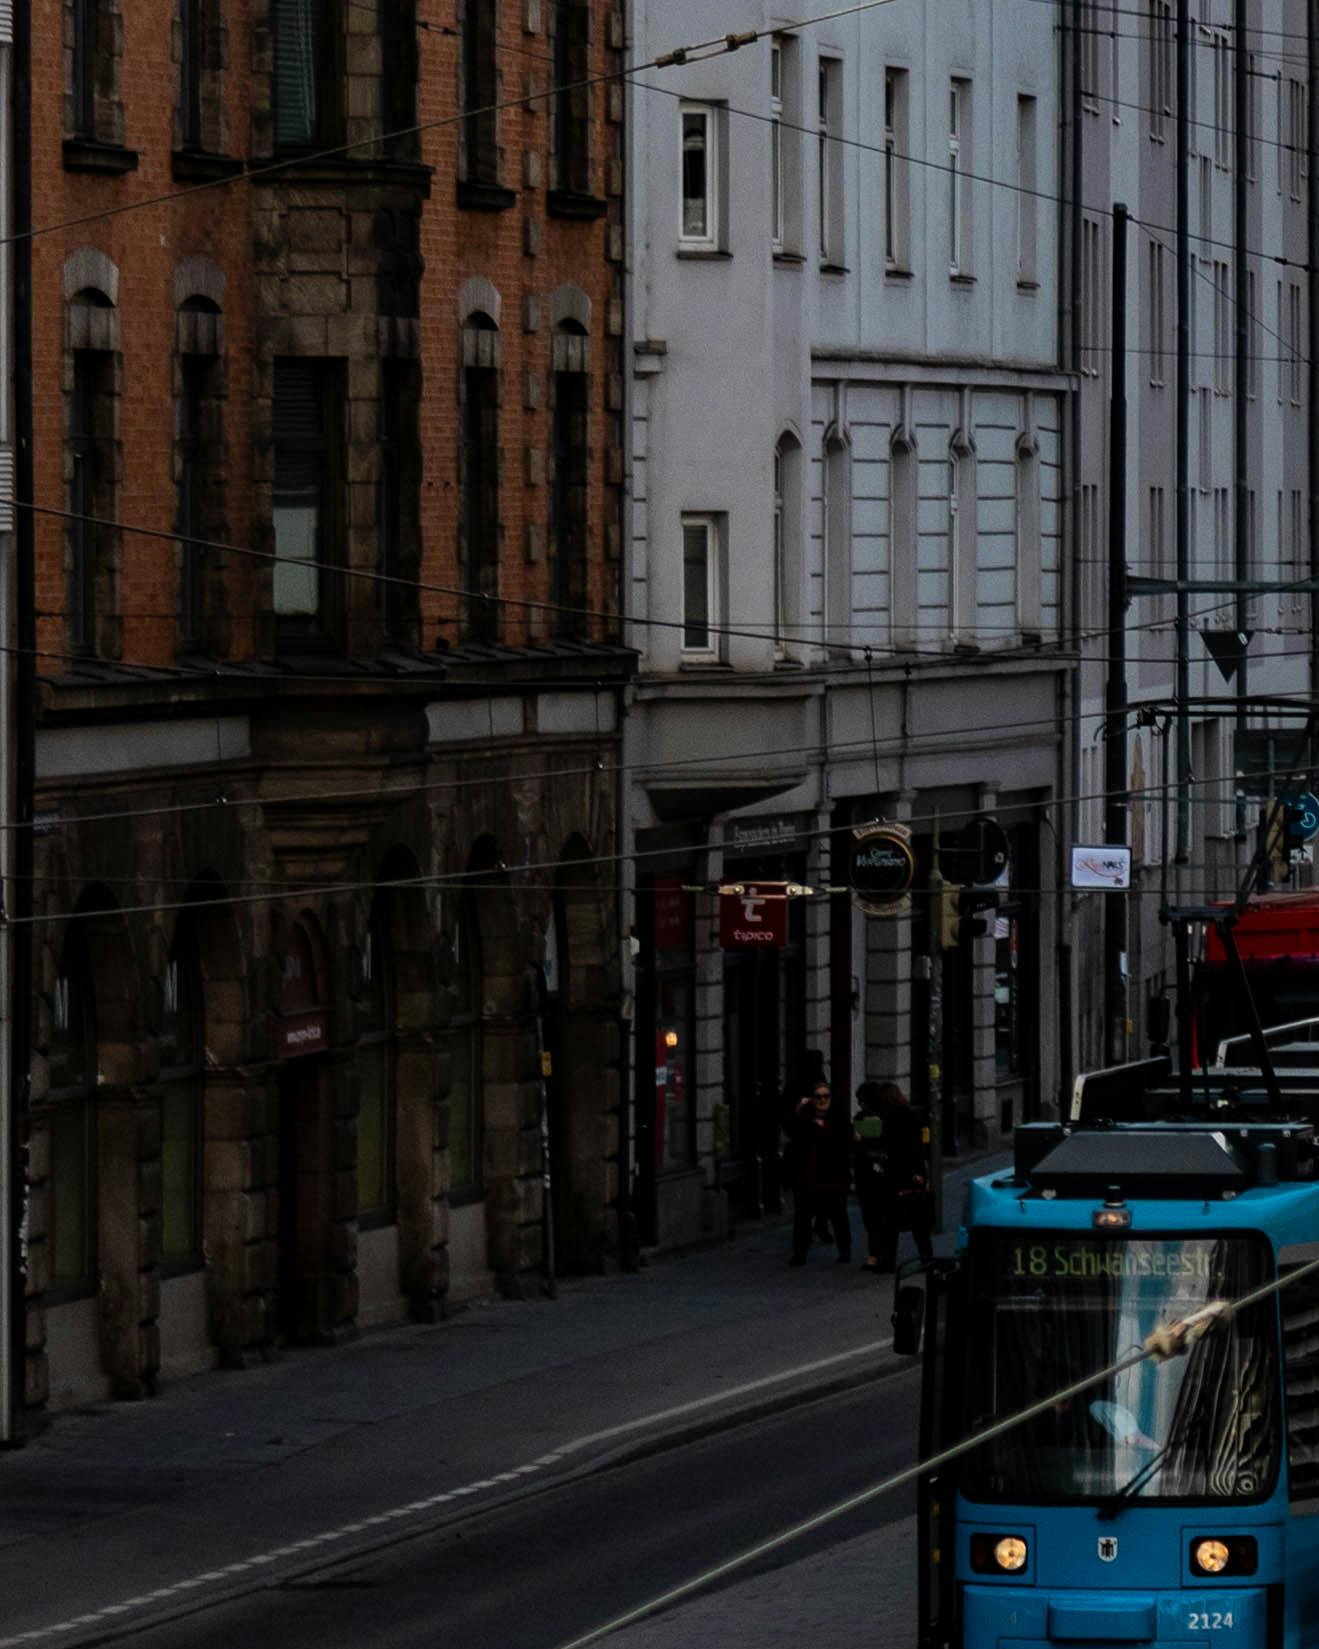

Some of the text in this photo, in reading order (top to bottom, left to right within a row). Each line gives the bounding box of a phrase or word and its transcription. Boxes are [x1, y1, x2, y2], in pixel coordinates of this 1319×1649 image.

[733, 928, 774, 943] tipico
[1013, 1245, 1224, 1278] 18 Schwanseestr.
[1187, 1611, 1235, 1631] 2124
